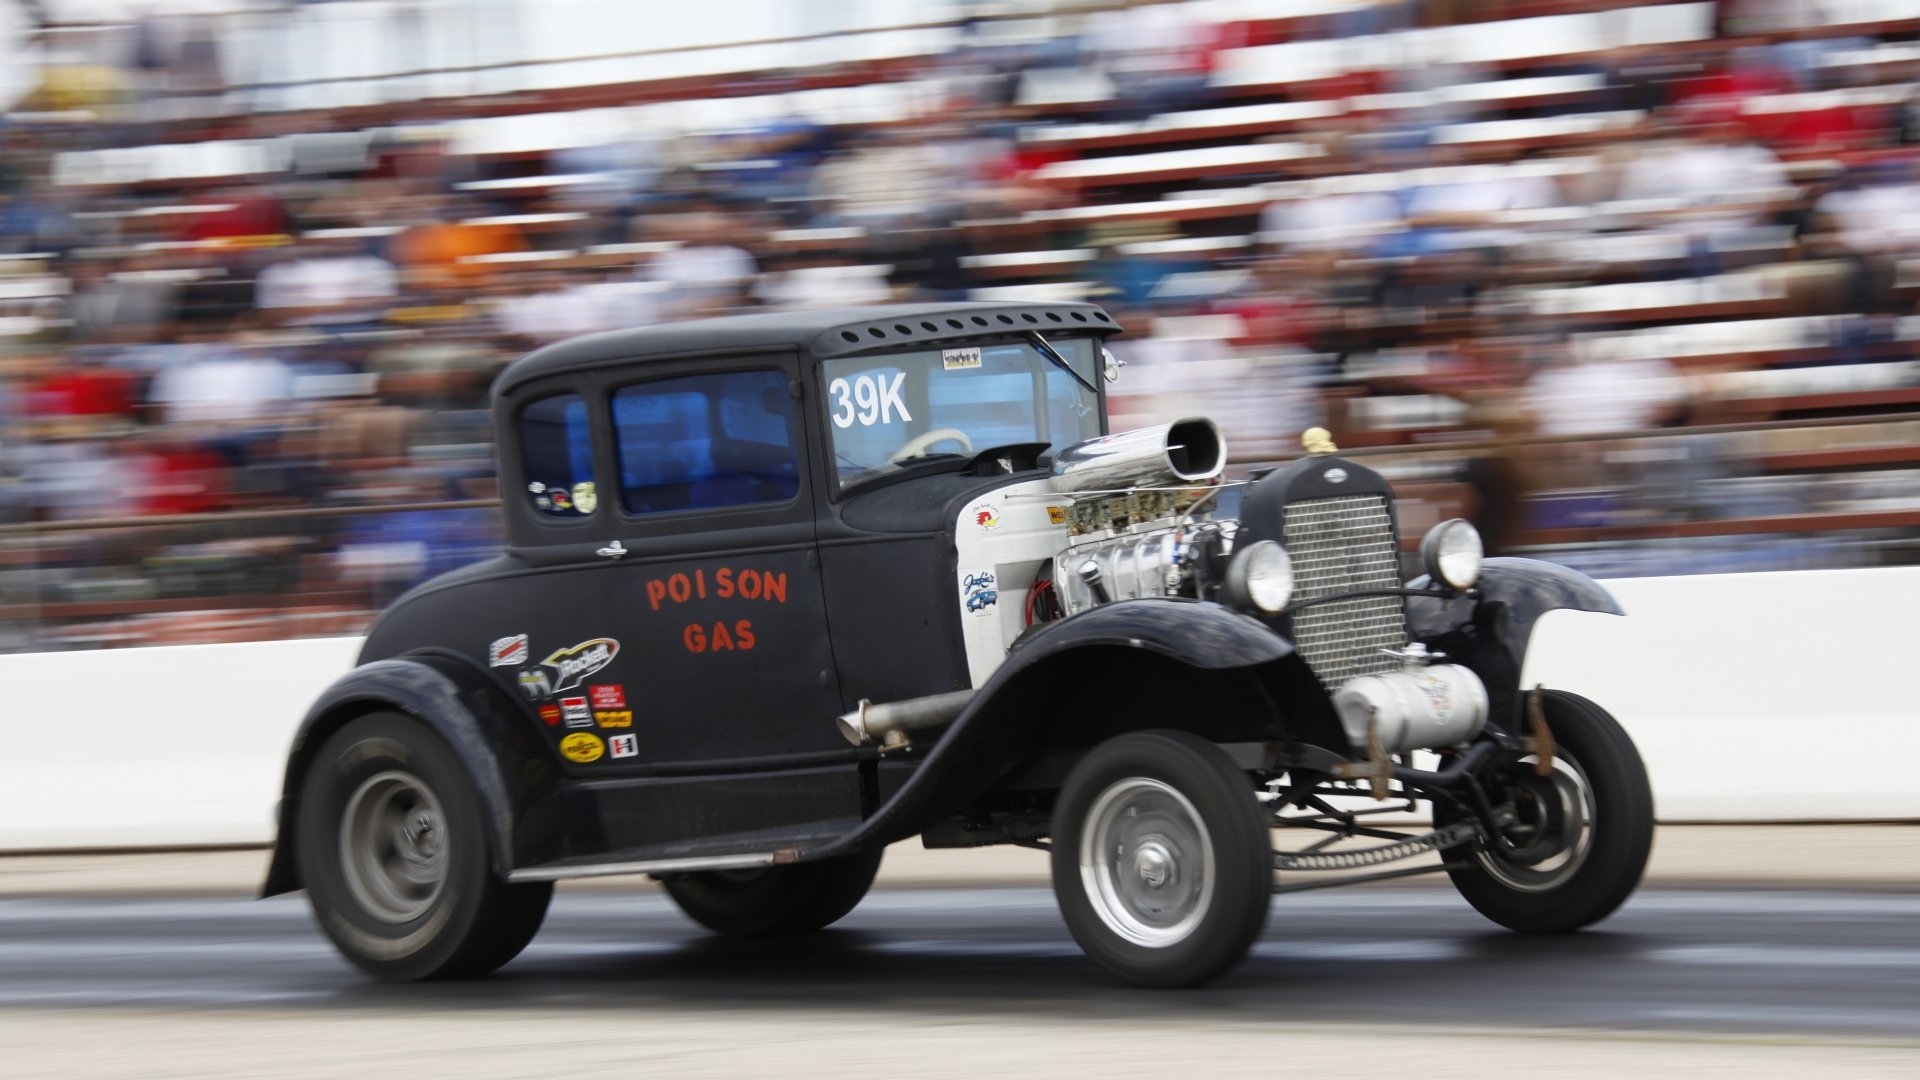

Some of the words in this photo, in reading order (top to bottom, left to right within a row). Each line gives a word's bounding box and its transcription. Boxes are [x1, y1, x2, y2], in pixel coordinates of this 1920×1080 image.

[829, 371, 912, 429] 39K
[646, 567, 787, 611] POISON
[683, 619, 756, 652] GAS
